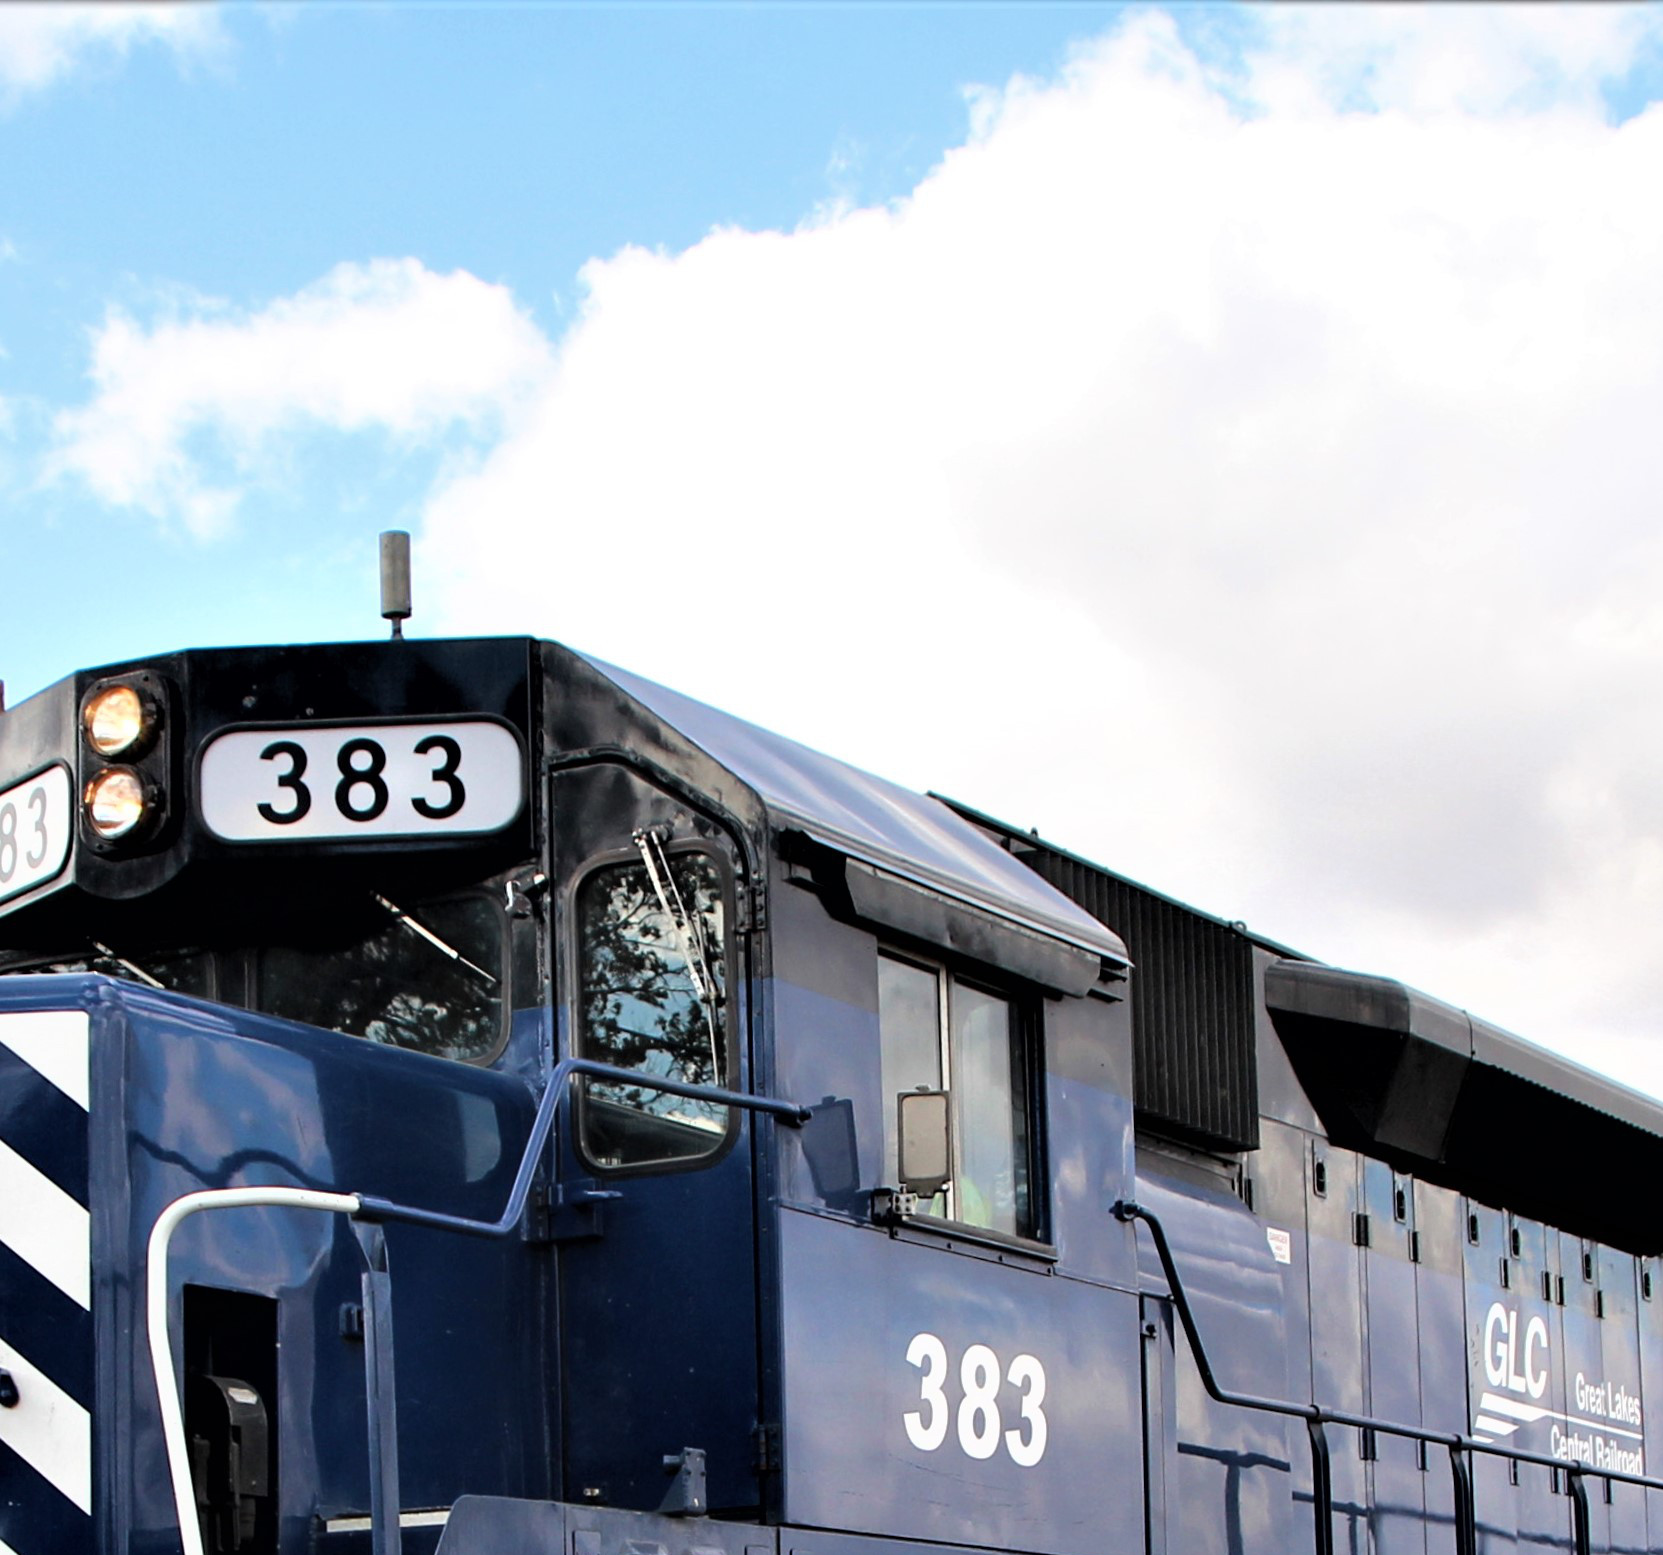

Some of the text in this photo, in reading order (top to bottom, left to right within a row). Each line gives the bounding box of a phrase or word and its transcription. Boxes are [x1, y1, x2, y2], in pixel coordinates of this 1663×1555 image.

[257, 735, 466, 825] 383
[1484, 1302, 1547, 1399] GLC
[903, 1333, 1047, 1467] 383
[1575, 1372, 1641, 1426] Great Lakes
[1550, 1424, 1642, 1477] Central Railroad
